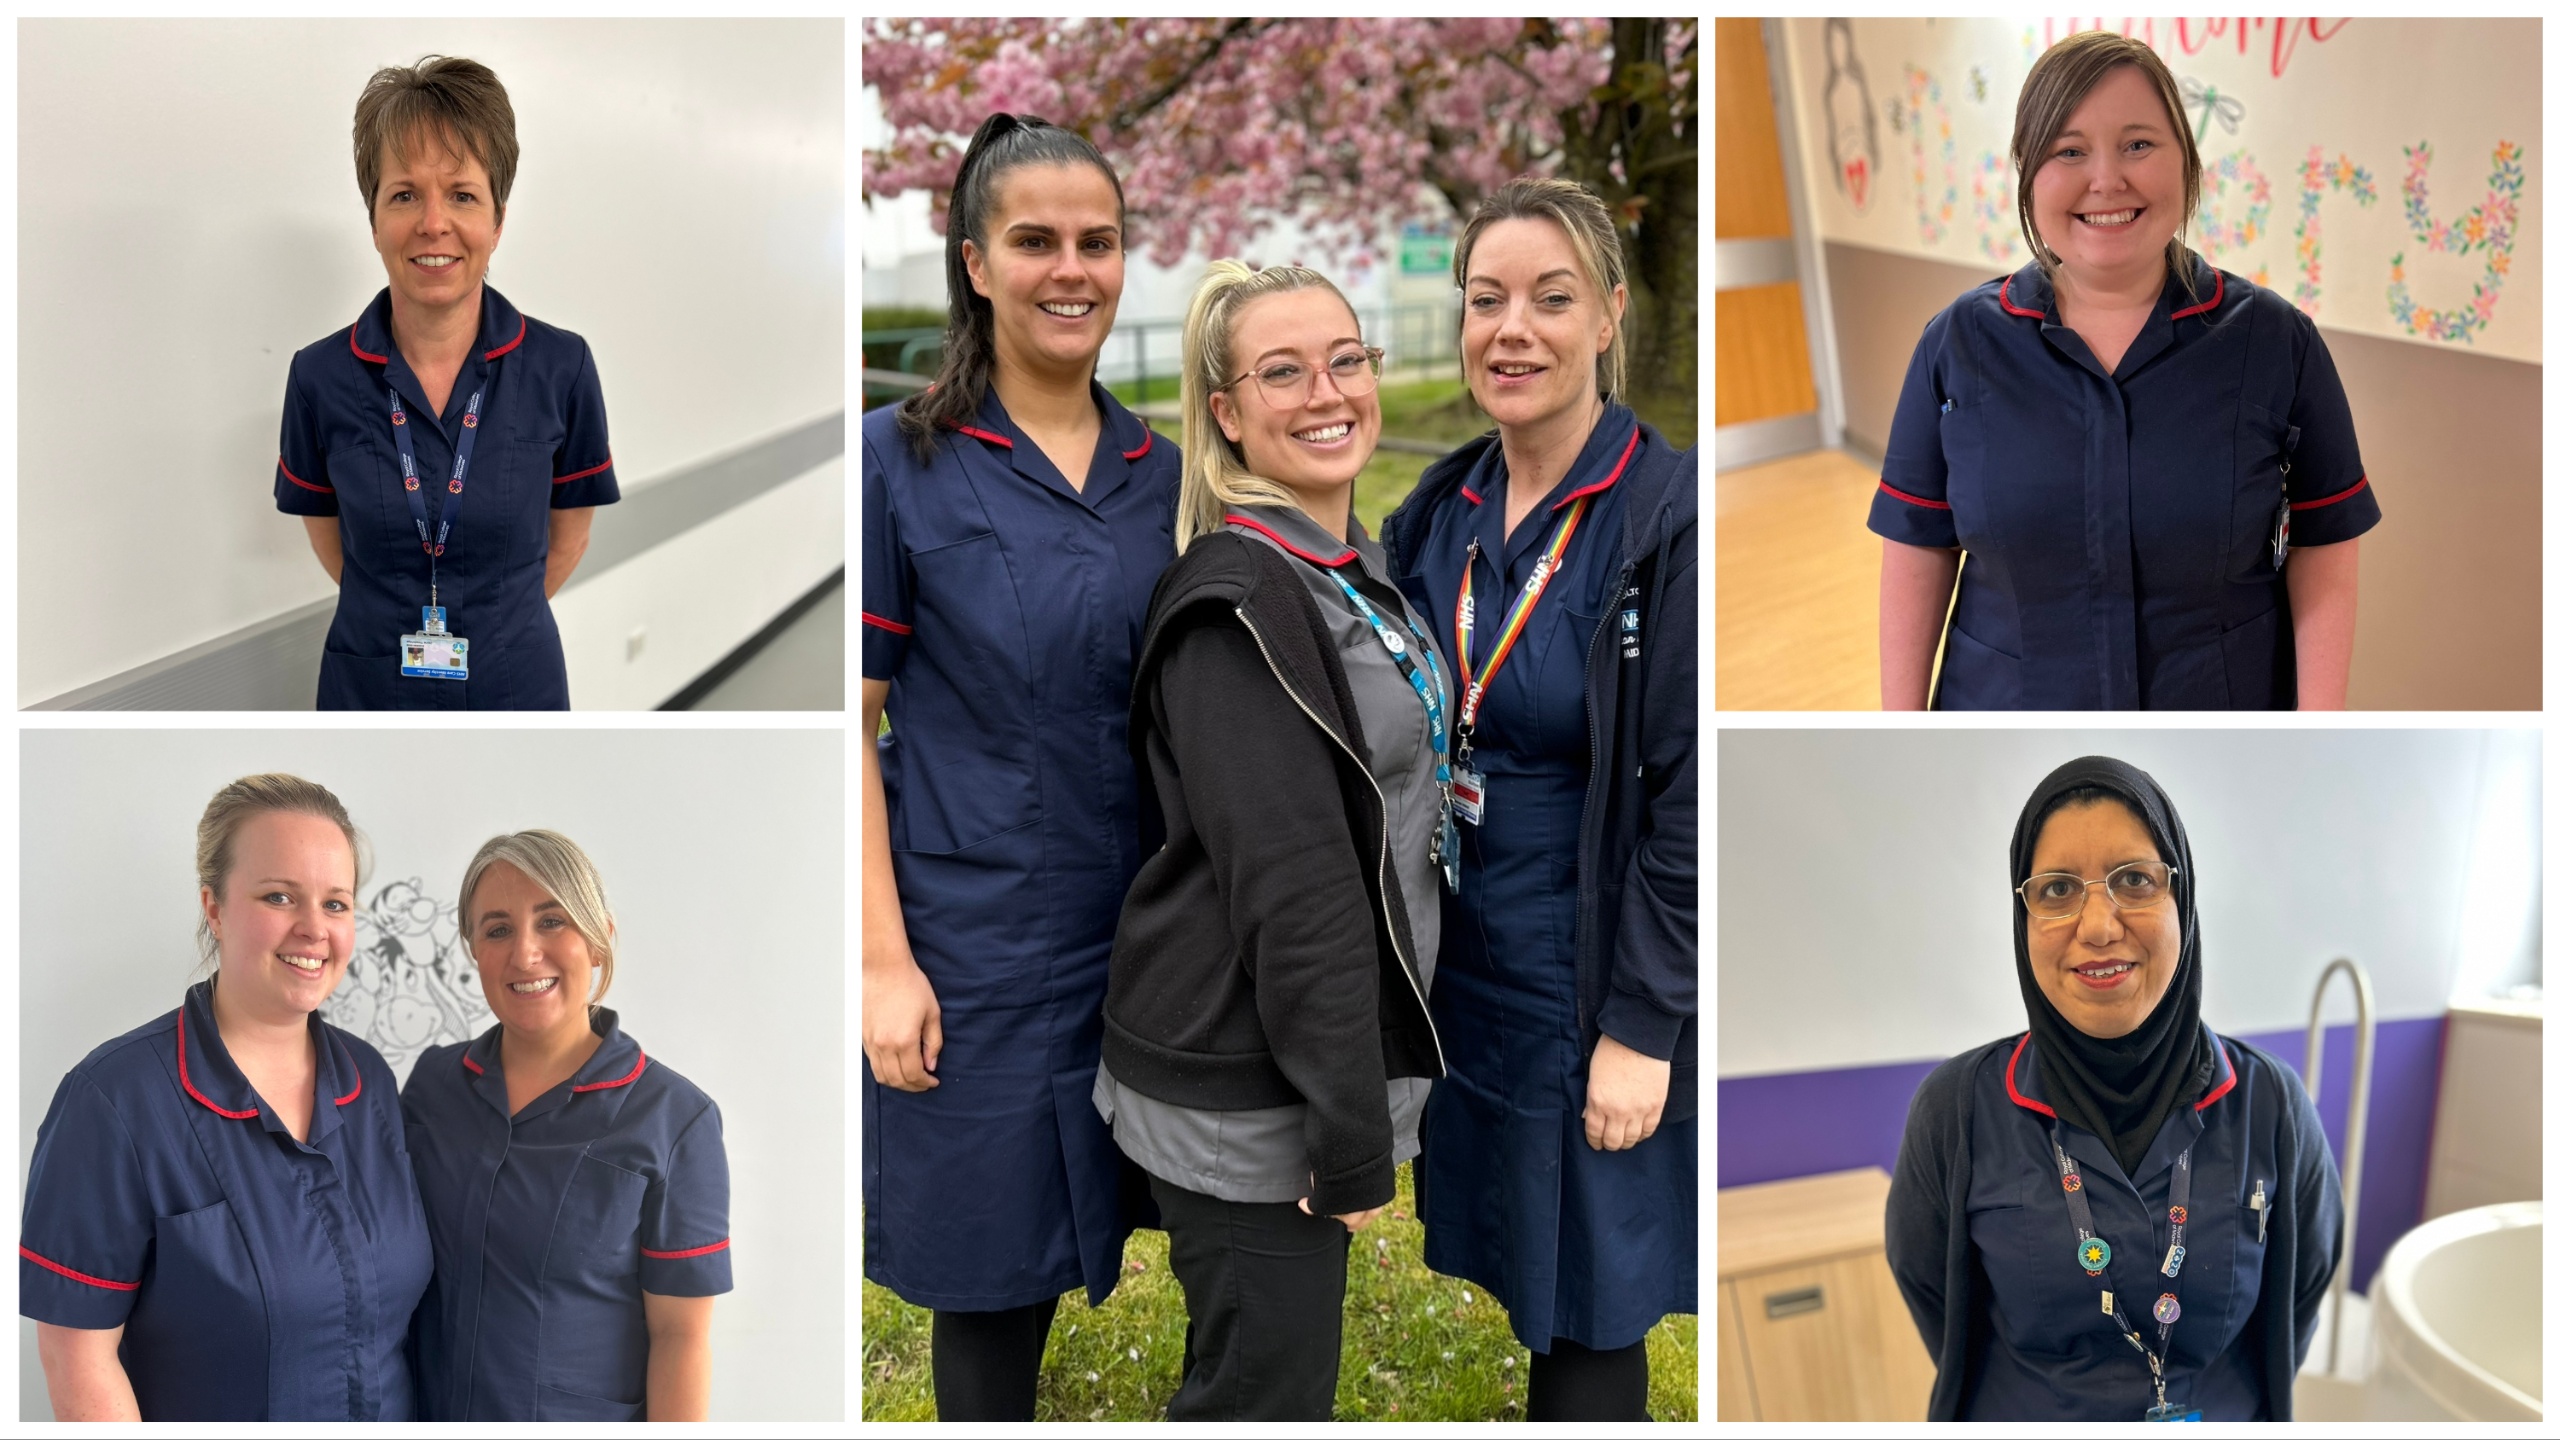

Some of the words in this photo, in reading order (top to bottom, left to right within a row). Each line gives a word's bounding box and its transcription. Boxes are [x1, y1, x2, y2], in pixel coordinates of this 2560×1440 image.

[1352, 595, 1376, 617] NHS
[1458, 592, 1475, 631] NHS
[1421, 687, 1436, 712] NHS
[1463, 682, 1483, 722] NHS
[1431, 714, 1443, 737] NHS
